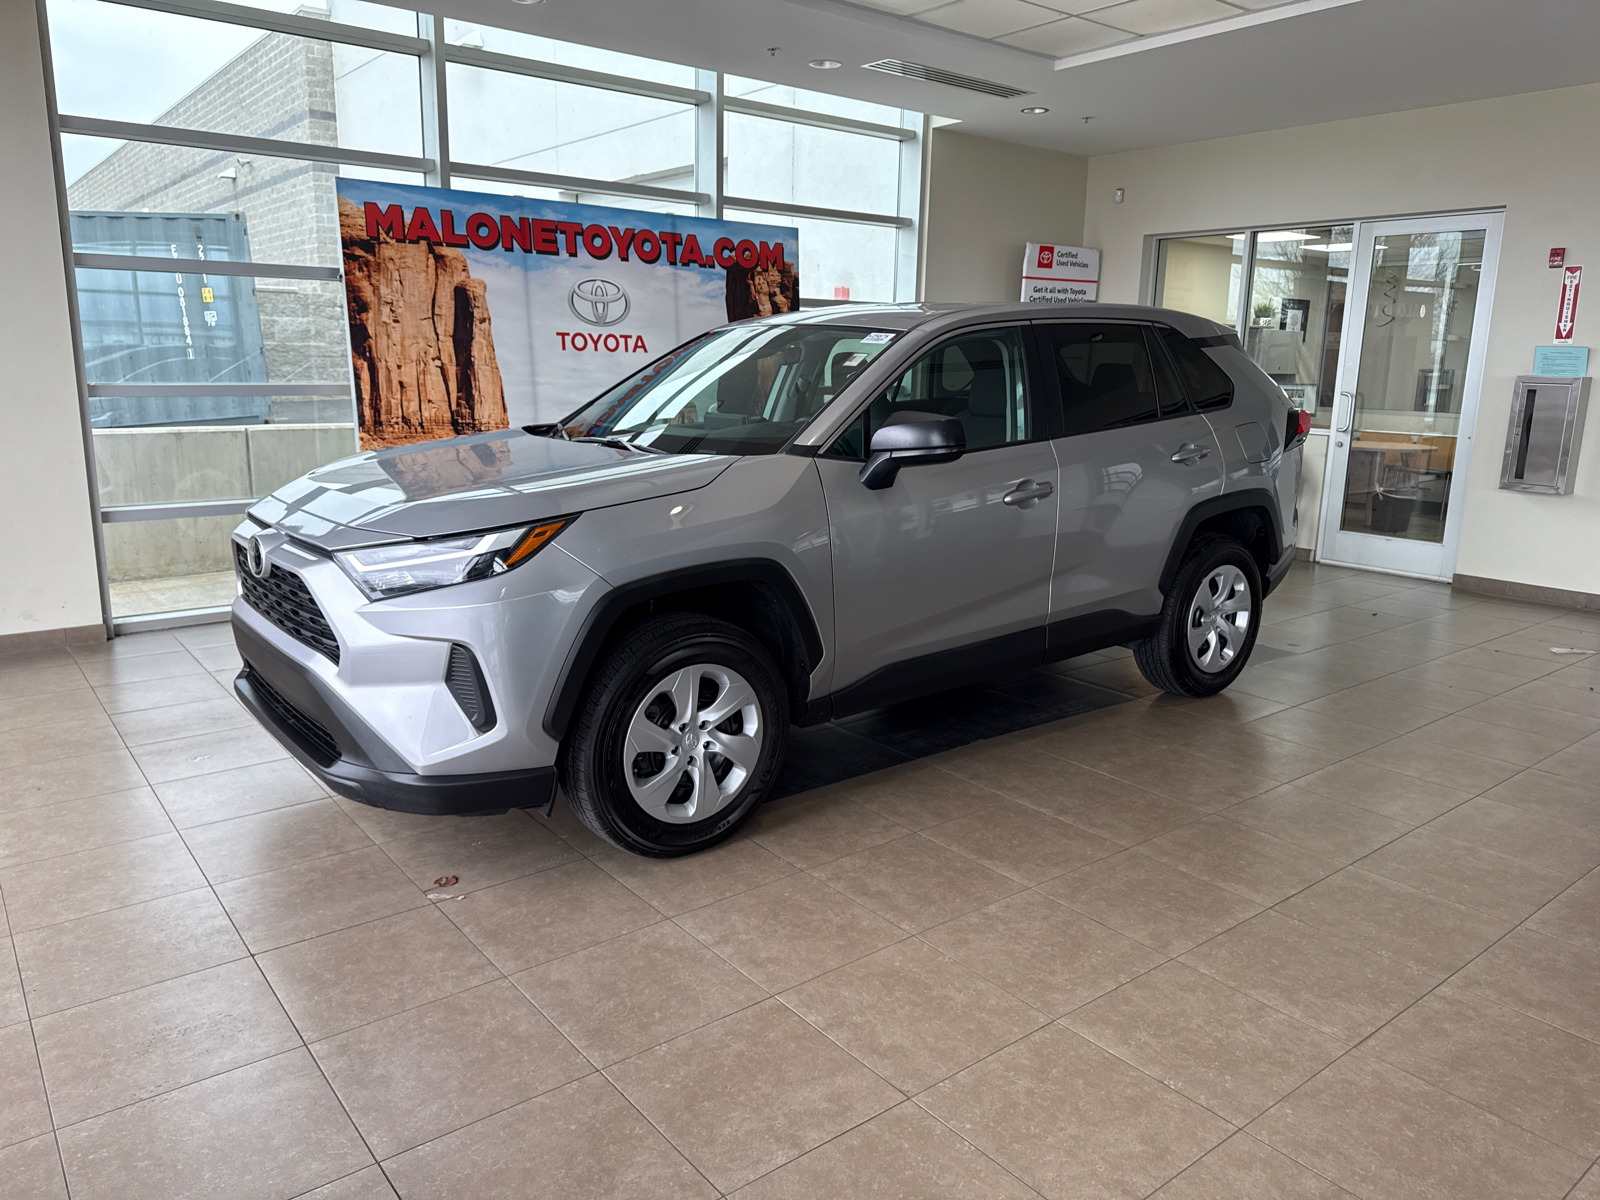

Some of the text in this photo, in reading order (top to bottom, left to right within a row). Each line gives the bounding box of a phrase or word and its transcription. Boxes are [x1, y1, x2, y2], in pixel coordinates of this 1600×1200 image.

[364, 202, 784, 271] MALONETOYOTA.COM
[1057, 251, 1079, 260] Certified
[1069, 261, 1089, 269] Vehicles
[1033, 286, 1087, 297] Get it all with Toyota
[1029, 295, 1053, 303] Certified
[1562, 279, 1574, 333] EXTINGUISHER
[556, 331, 648, 353] TOYOTA
